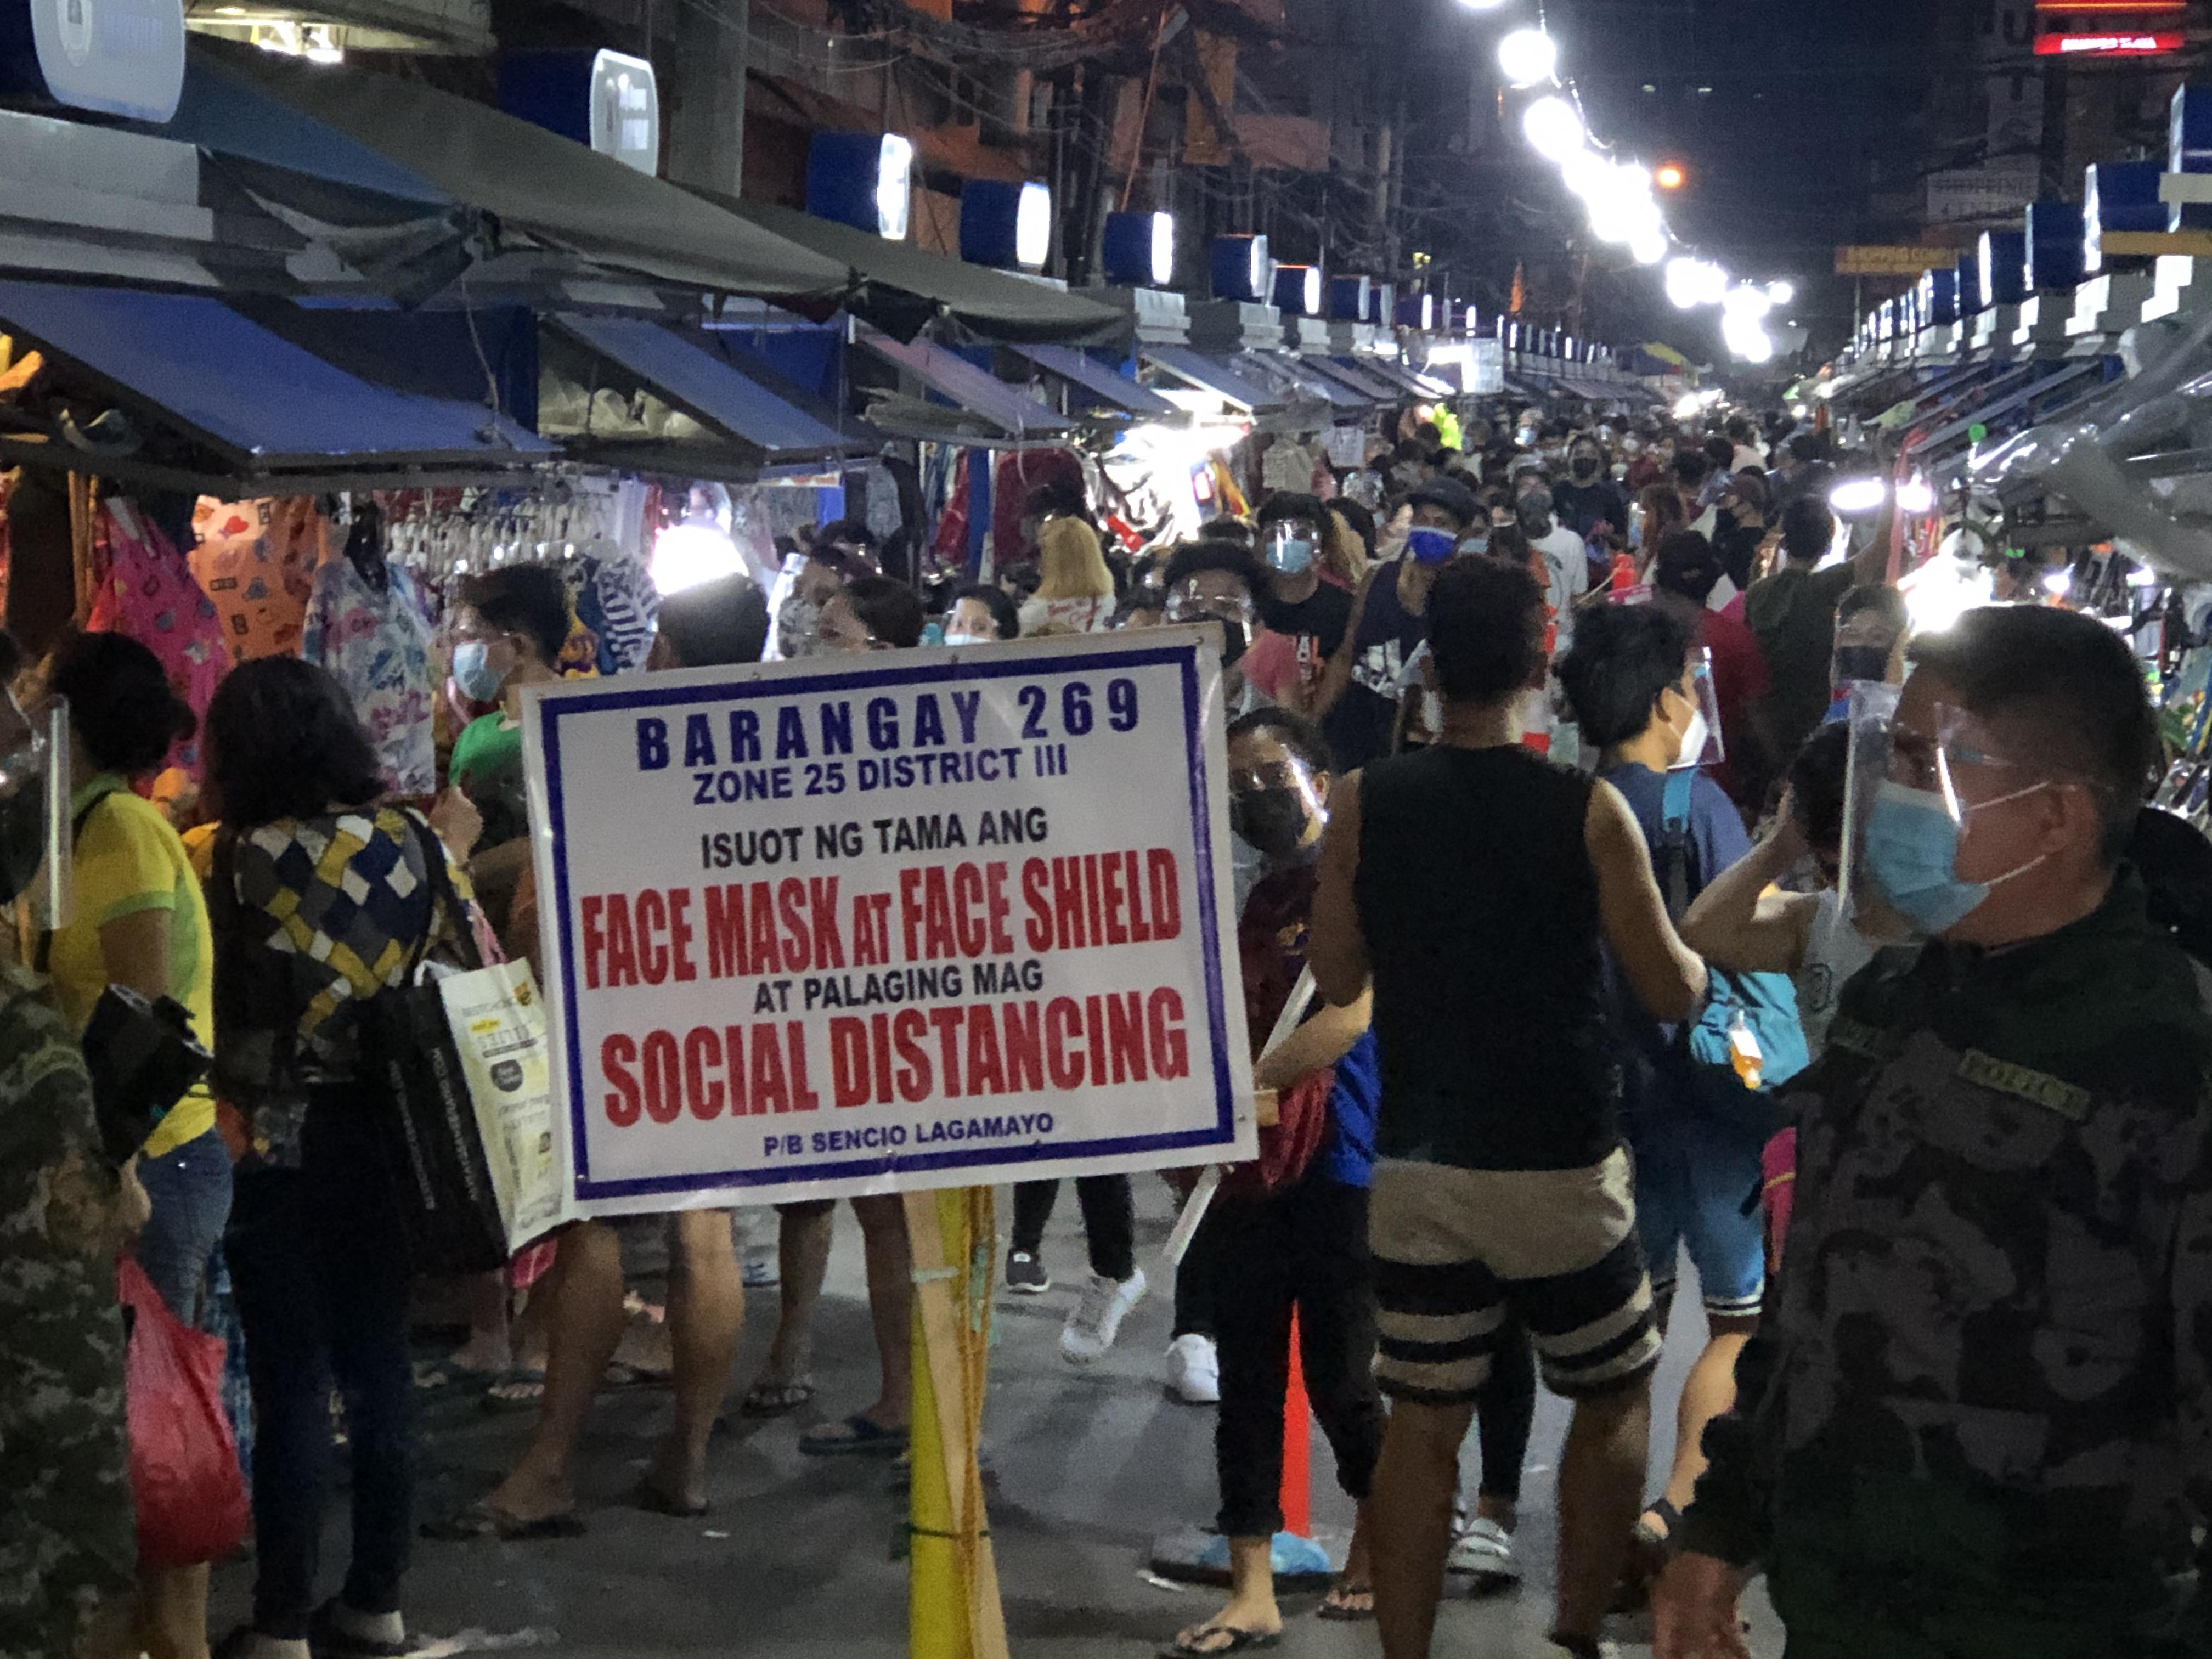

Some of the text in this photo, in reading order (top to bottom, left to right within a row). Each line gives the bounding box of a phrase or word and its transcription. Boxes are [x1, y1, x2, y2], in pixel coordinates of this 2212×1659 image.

[636, 678, 1138, 771] BARANGAY 269
[693, 743, 1067, 805] ZONE 25 DISTRICT III
[702, 806, 1048, 869] ISUOT NG TAMA ANG
[581, 848, 1181, 989] FACE MASK AT FACE SHIELD
[754, 959, 1043, 1014] AT PALAGING MAG
[601, 1020, 819, 1127] SOCIAL
[830, 987, 1189, 1108] DISTANCING
[764, 1113, 1053, 1156] P/B SENCIO LAGAMAYO
